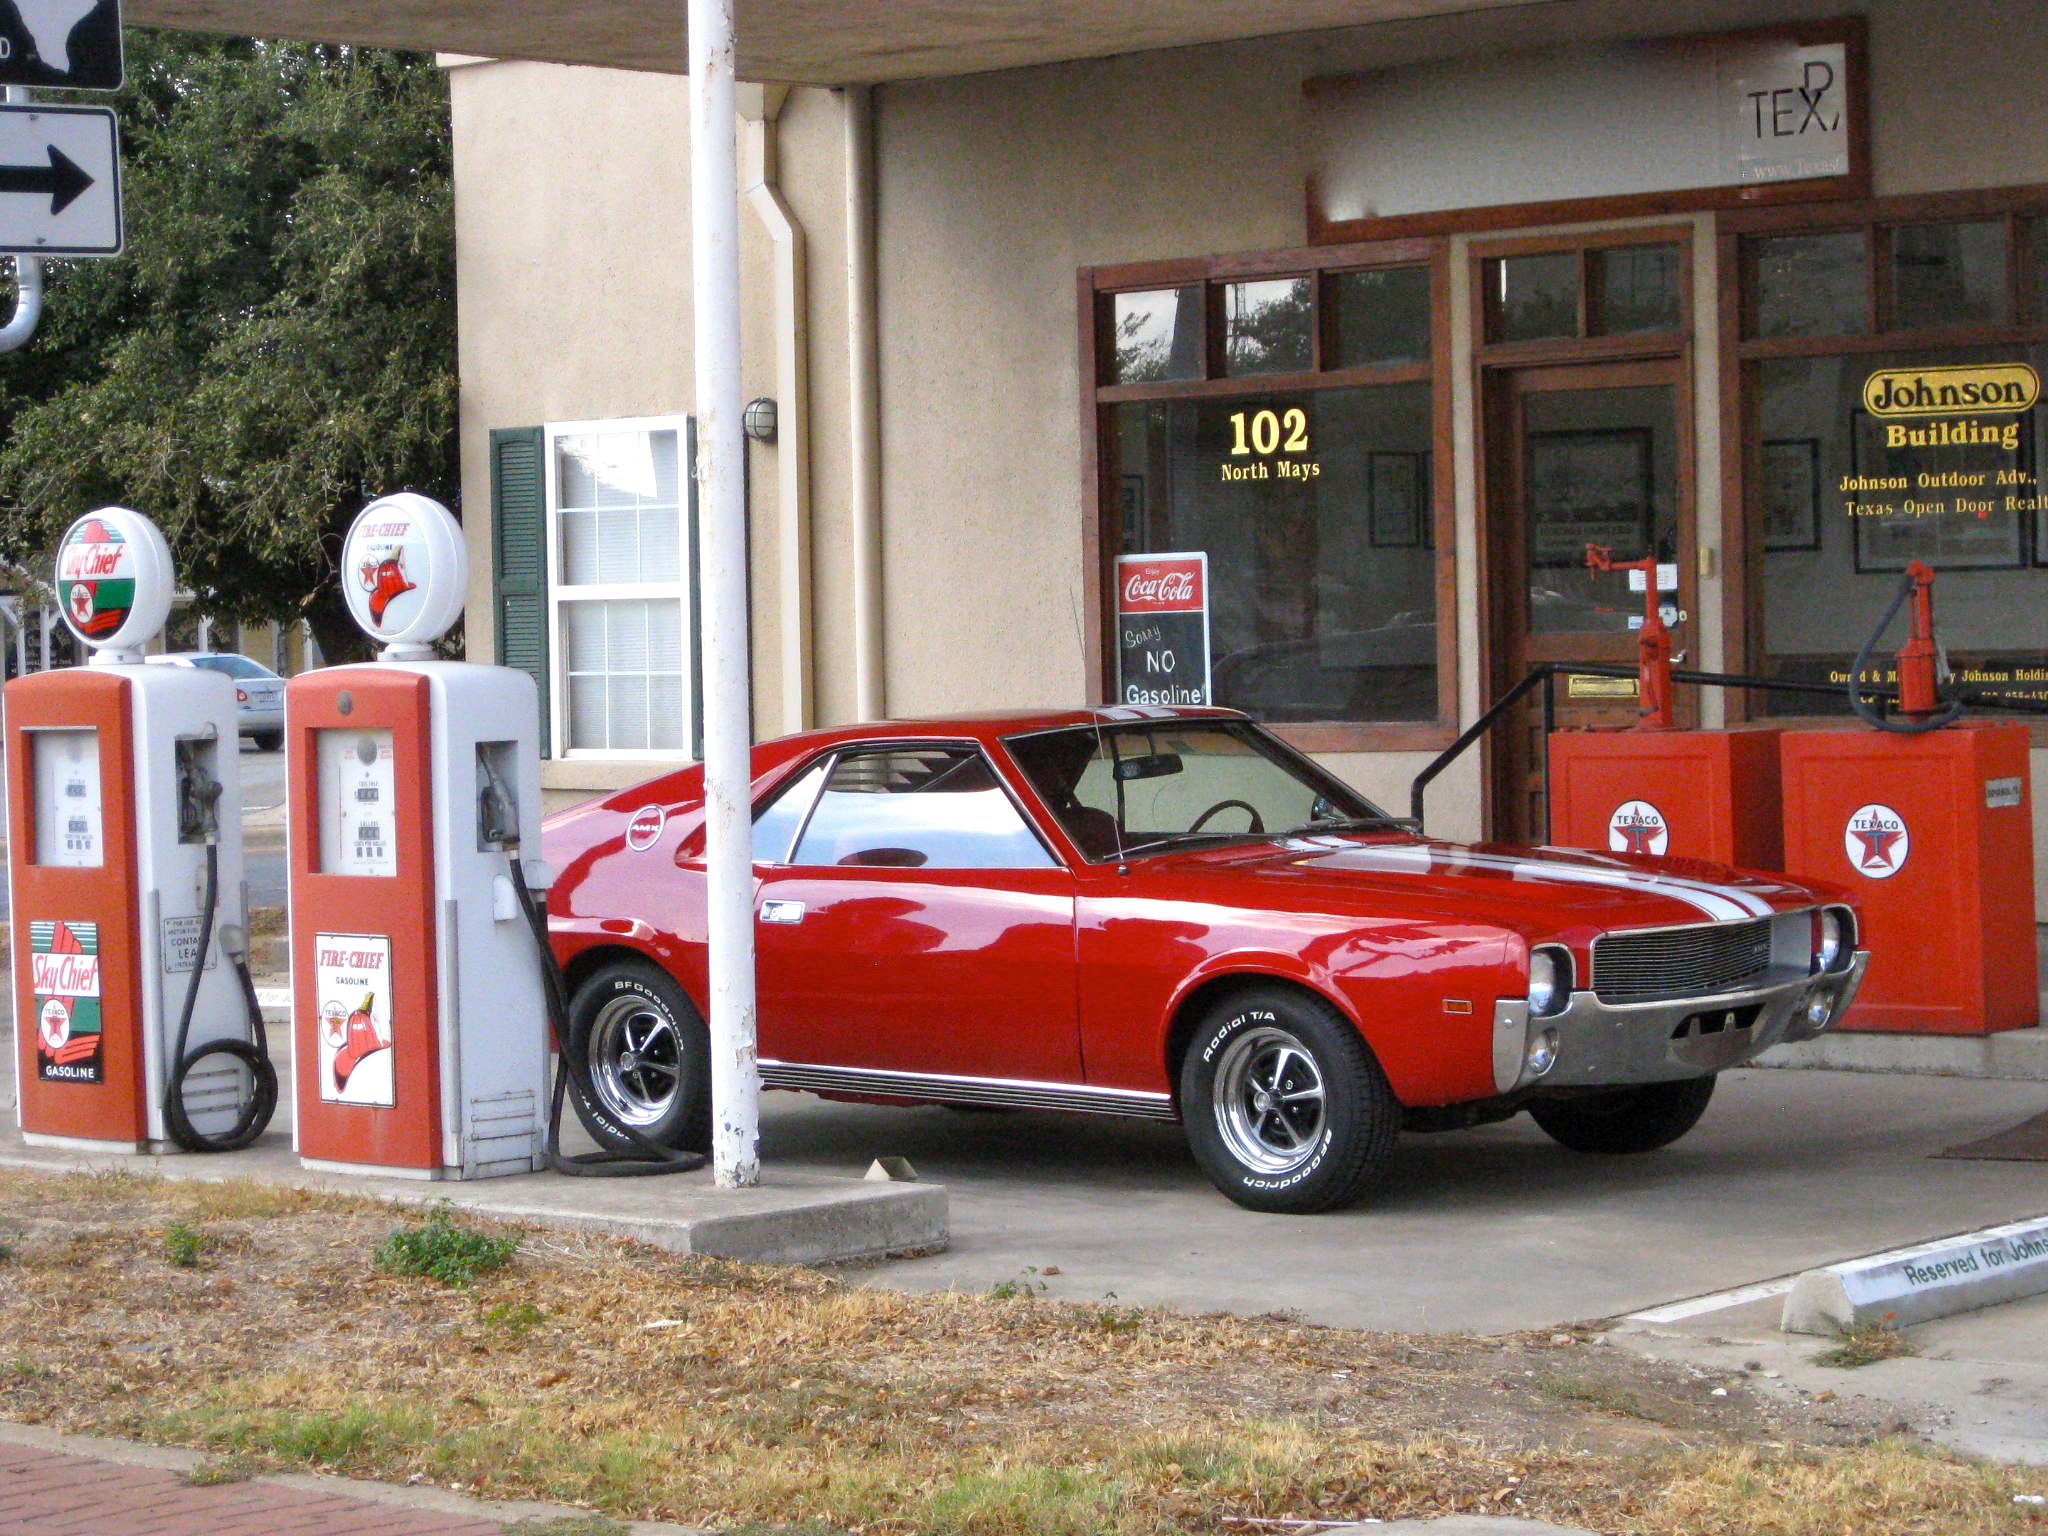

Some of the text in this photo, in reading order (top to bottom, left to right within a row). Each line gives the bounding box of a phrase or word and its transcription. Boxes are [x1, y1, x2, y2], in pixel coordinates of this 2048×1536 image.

[1874, 378, 2026, 409] Johnson
[1230, 408, 1308, 455] 102
[1886, 420, 2020, 450] Building
[1222, 460, 1320, 482] North Mays
[1839, 476, 1909, 491] Johnson
[1918, 472, 1986, 488] Outdoor
[1845, 501, 1894, 517] Texas
[1904, 499, 1945, 518] Open
[1956, 498, 1995, 513] Door
[85, 544, 123, 575] Chief
[1124, 572, 1195, 603] Coca-Cola
[1125, 624, 1161, 648] Sorry
[1146, 650, 1175, 673] NO
[1830, 671, 1867, 682] Owd
[1962, 669, 2009, 682] Johnson
[1616, 815, 1659, 825] TEXACO
[1853, 818, 1899, 830] TEXACO
[178, 948, 198, 959] LEA
[319, 949, 385, 969] FIRE-CHIEF
[34, 955, 98, 995] Sky Chief
[335, 975, 369, 986] GASOLINE
[44, 1008, 65, 1016] TEXACO
[1203, 1011, 1275, 1063] Radial T/A
[45, 1064, 95, 1079] GASOLINE
[1243, 1128, 1333, 1191] BFGoodrich
[1903, 1250, 1979, 1286] Reserved
[1981, 1248, 2006, 1268] for
